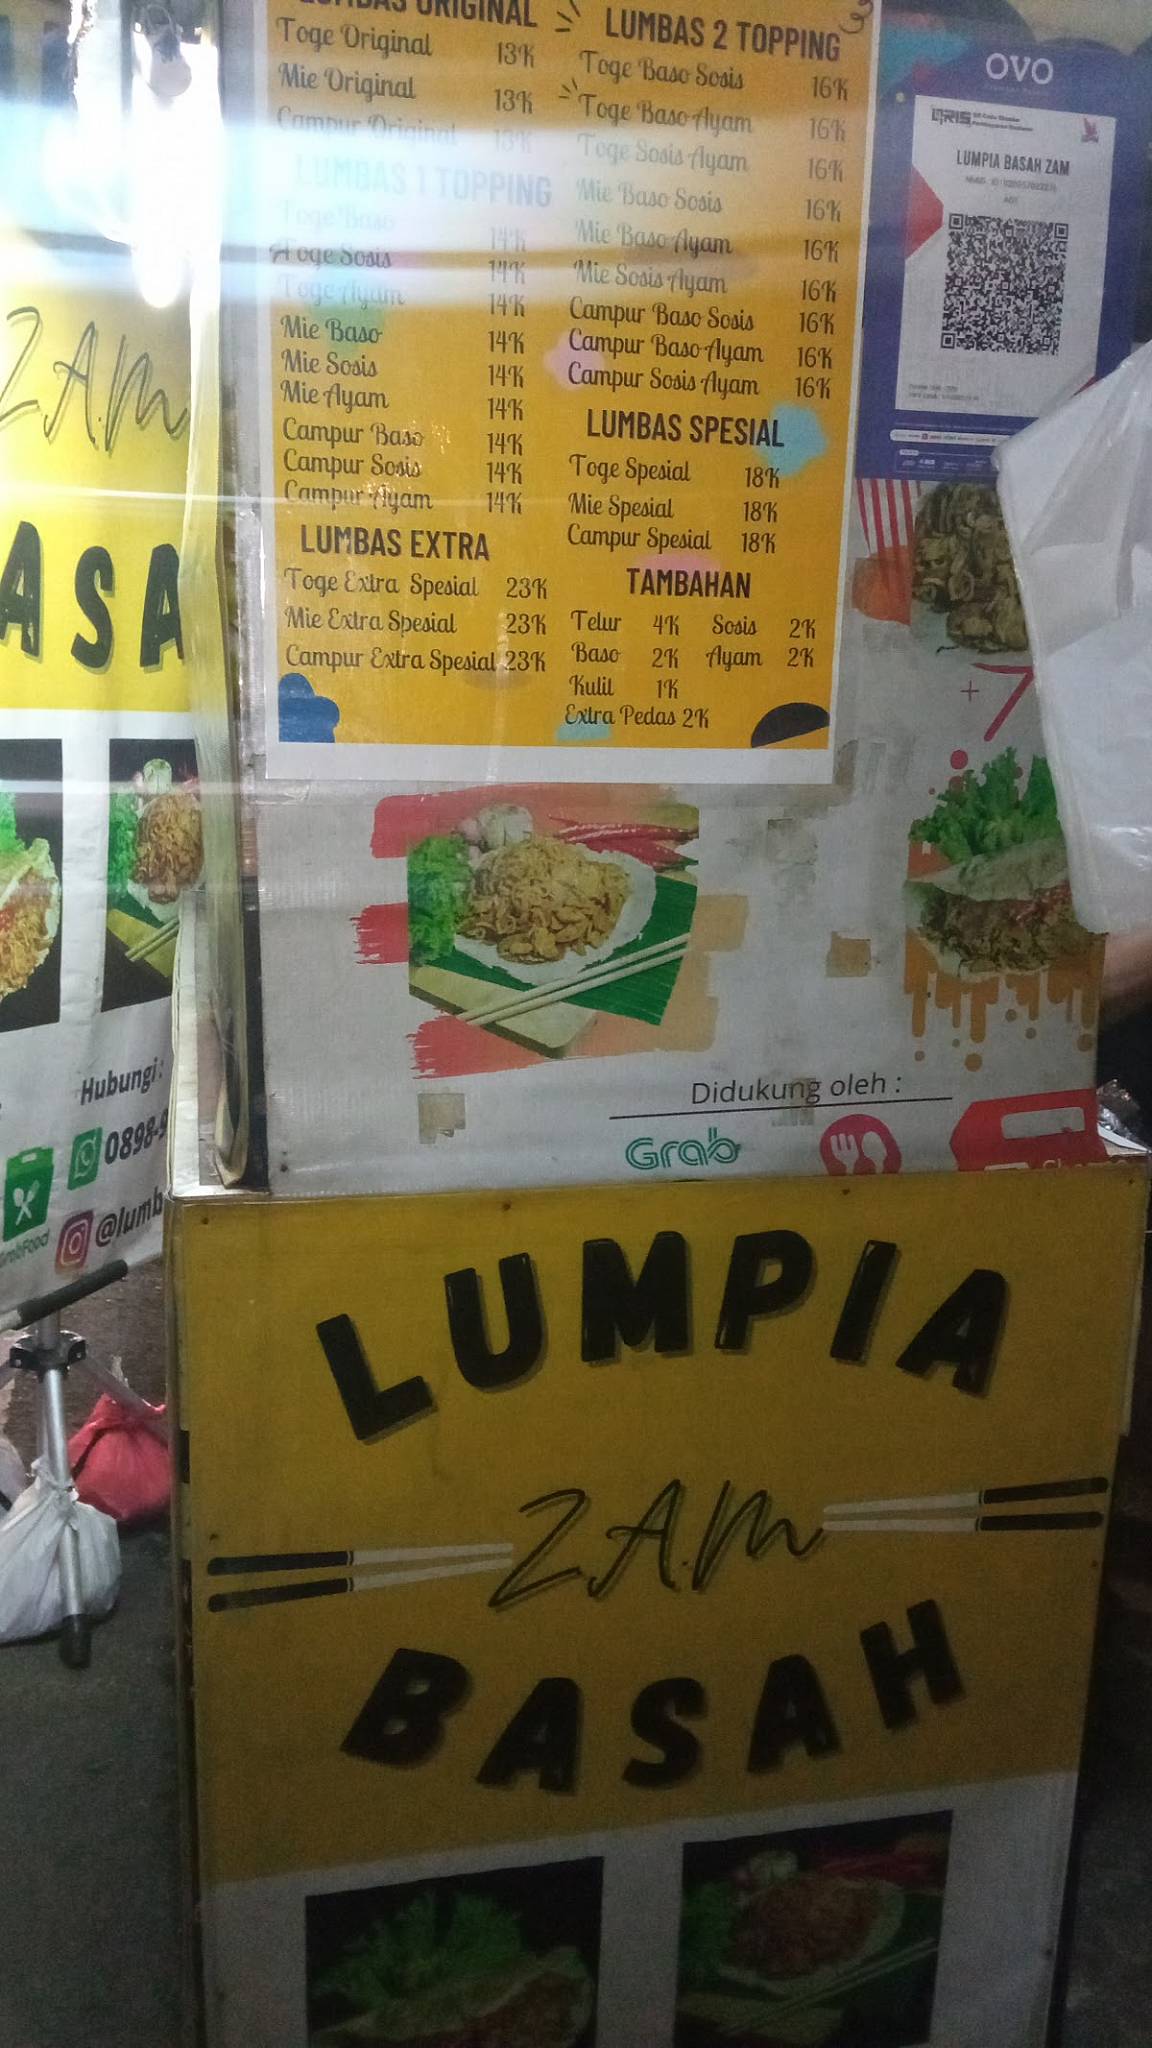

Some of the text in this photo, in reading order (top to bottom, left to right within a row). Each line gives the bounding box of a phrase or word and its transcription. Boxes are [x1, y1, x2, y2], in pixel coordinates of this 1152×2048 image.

[276, 16, 535, 68] Toge Original 13K
[605, 7, 841, 62] LUMBAS 2 TOPPING
[278, 62, 533, 114] Mie Original 13K
[579, 50, 849, 101] Toge Baso Sosis 16K
[985, 52, 1054, 85] OVO
[277, 105, 362, 139] Campur
[368, 113, 458, 147] Original
[578, 93, 846, 143] Toge Baso Ayam 16K
[577, 132, 844, 183] Toge Sosis Ayam 16K
[956, 149, 1070, 176] LUMPIA BASAH ZAM
[296, 153, 553, 208] LUMBAS 1 TOPPING
[576, 176, 842, 223] Mie Baso Sosis 16K
[575, 219, 839, 263] Mie Baso Ayam 16K
[489, 258, 526, 284] 14K
[573, 258, 837, 303] Mie Sosis Ayam 16K
[489, 293, 525, 317] 14K
[569, 296, 835, 335] Campur Baso Sosis 16K
[280, 314, 525, 354] Mie Baso 14K
[568, 327, 832, 370] Campur Baso Ayam 16K
[281, 348, 524, 388] Mie Sosis 14K
[568, 360, 831, 401] Campur Sosis Ayam 16K
[280, 380, 524, 422] Mie Ayam 14K
[282, 416, 523, 457] Campur Baso 14K
[587, 408, 785, 448] LUMBAS SPESIAL
[283, 448, 523, 485] Campur Sosis 14K
[568, 453, 780, 489] Toge Spesial 18K
[284, 479, 522, 514] Campur Ayam 14K
[568, 492, 778, 523] Mie Spesial 18K
[300, 524, 490, 561] LUMBAS EXTRA
[567, 522, 776, 555] Campur Spesial 18K
[284, 567, 548, 601] Toge Extra Spesial 23K
[626, 567, 751, 599] TAMBAHAN
[284, 605, 547, 637] Mie Extra Spesial 23K
[570, 610, 817, 640] Telur 4K Sosis 2K
[285, 643, 546, 676] Campur Extra Spesial 23K
[571, 642, 815, 672] Baso 2K Ayam 2K
[569, 674, 679, 700] Kulit 1K
[564, 703, 710, 729] Extra Pedas 2K
[691, 1078, 821, 1105] Didukung
[830, 1072, 887, 1097] oleh
[625, 1127, 740, 1170] Grab
[315, 1228, 1011, 1442] LUMPIA
[340, 1600, 967, 1795] BASAH
